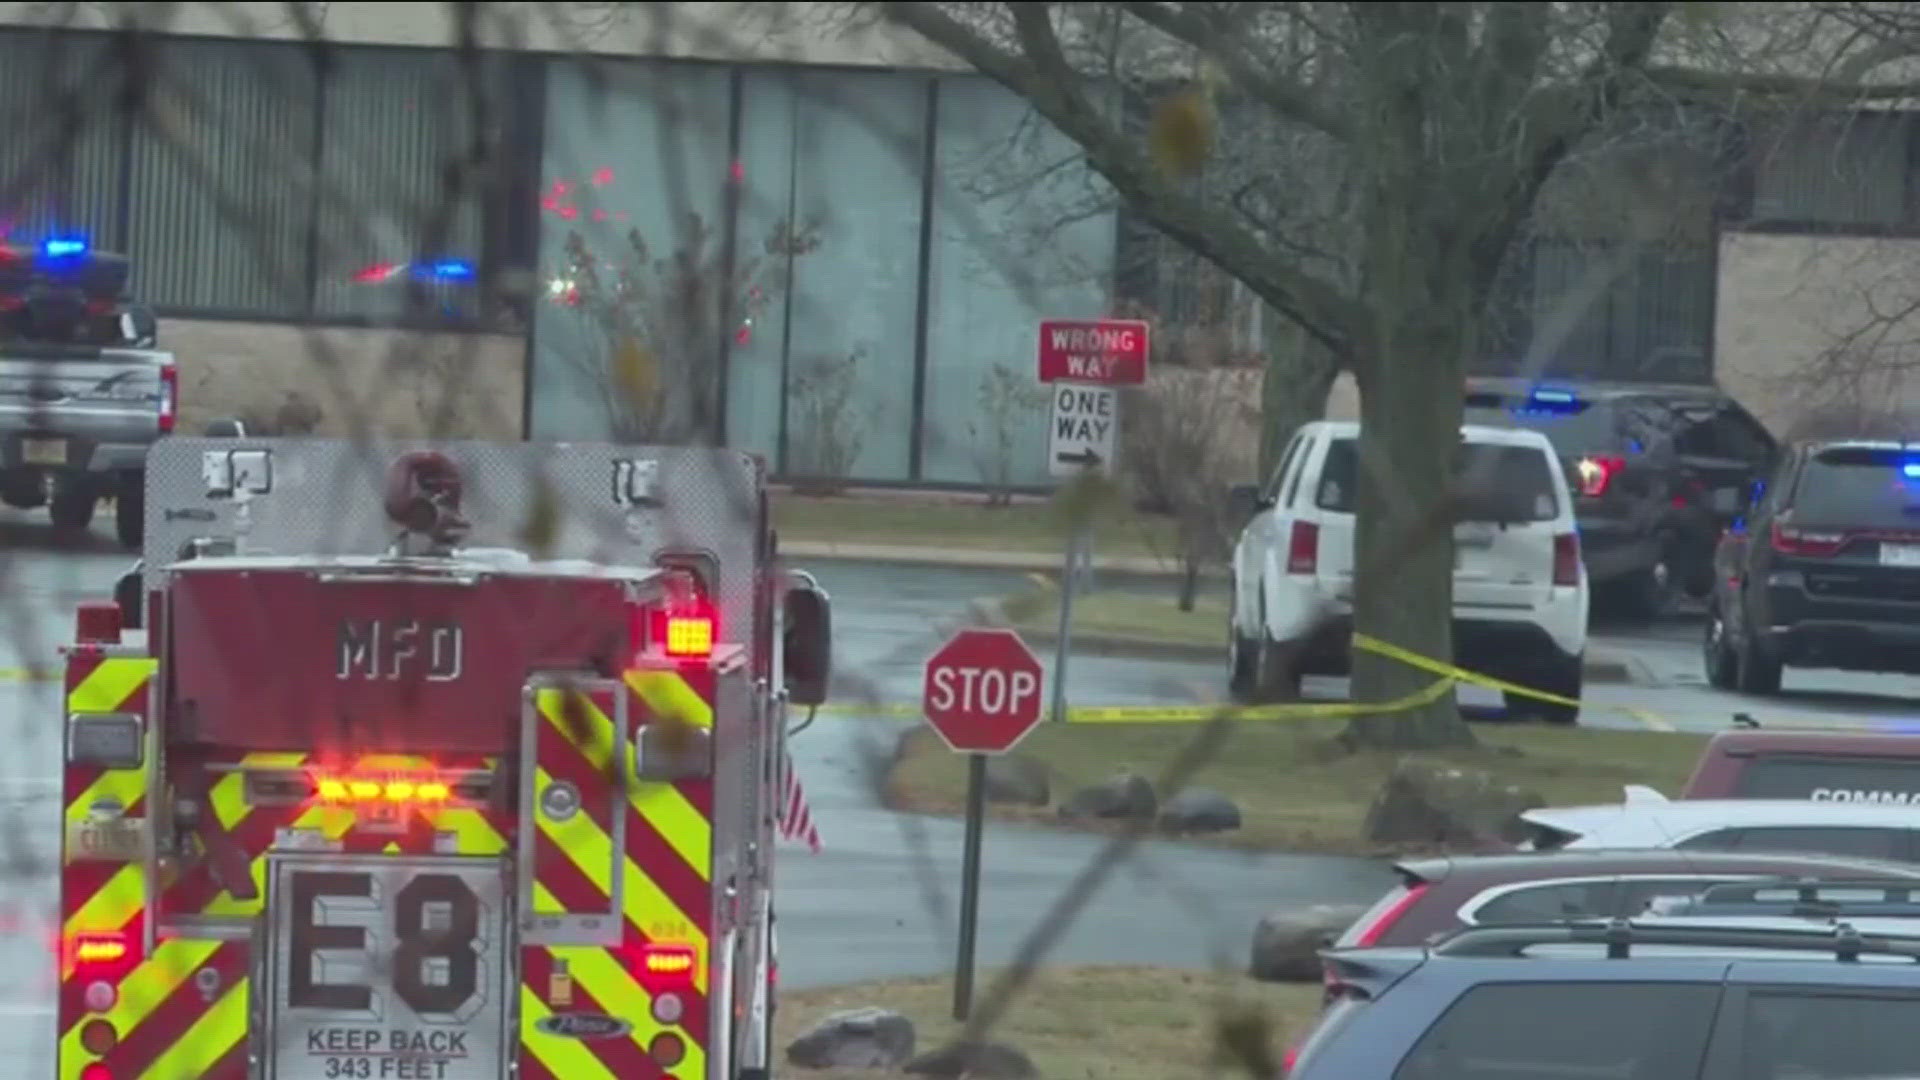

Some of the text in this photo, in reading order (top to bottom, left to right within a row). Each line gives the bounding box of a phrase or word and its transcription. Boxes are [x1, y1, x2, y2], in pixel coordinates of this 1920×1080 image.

[1052, 329, 1135, 352] WRONG
[1067, 356, 1117, 378] WAY
[1059, 389, 1111, 416] ONE
[1058, 417, 1110, 440] WAY
[336, 618, 462, 681] MFD
[931, 666, 1036, 715] STOP
[289, 872, 490, 1024] E8
[307, 1029, 467, 1053] KEEP BACK
[325, 1058, 449, 1080] 343 FEET
